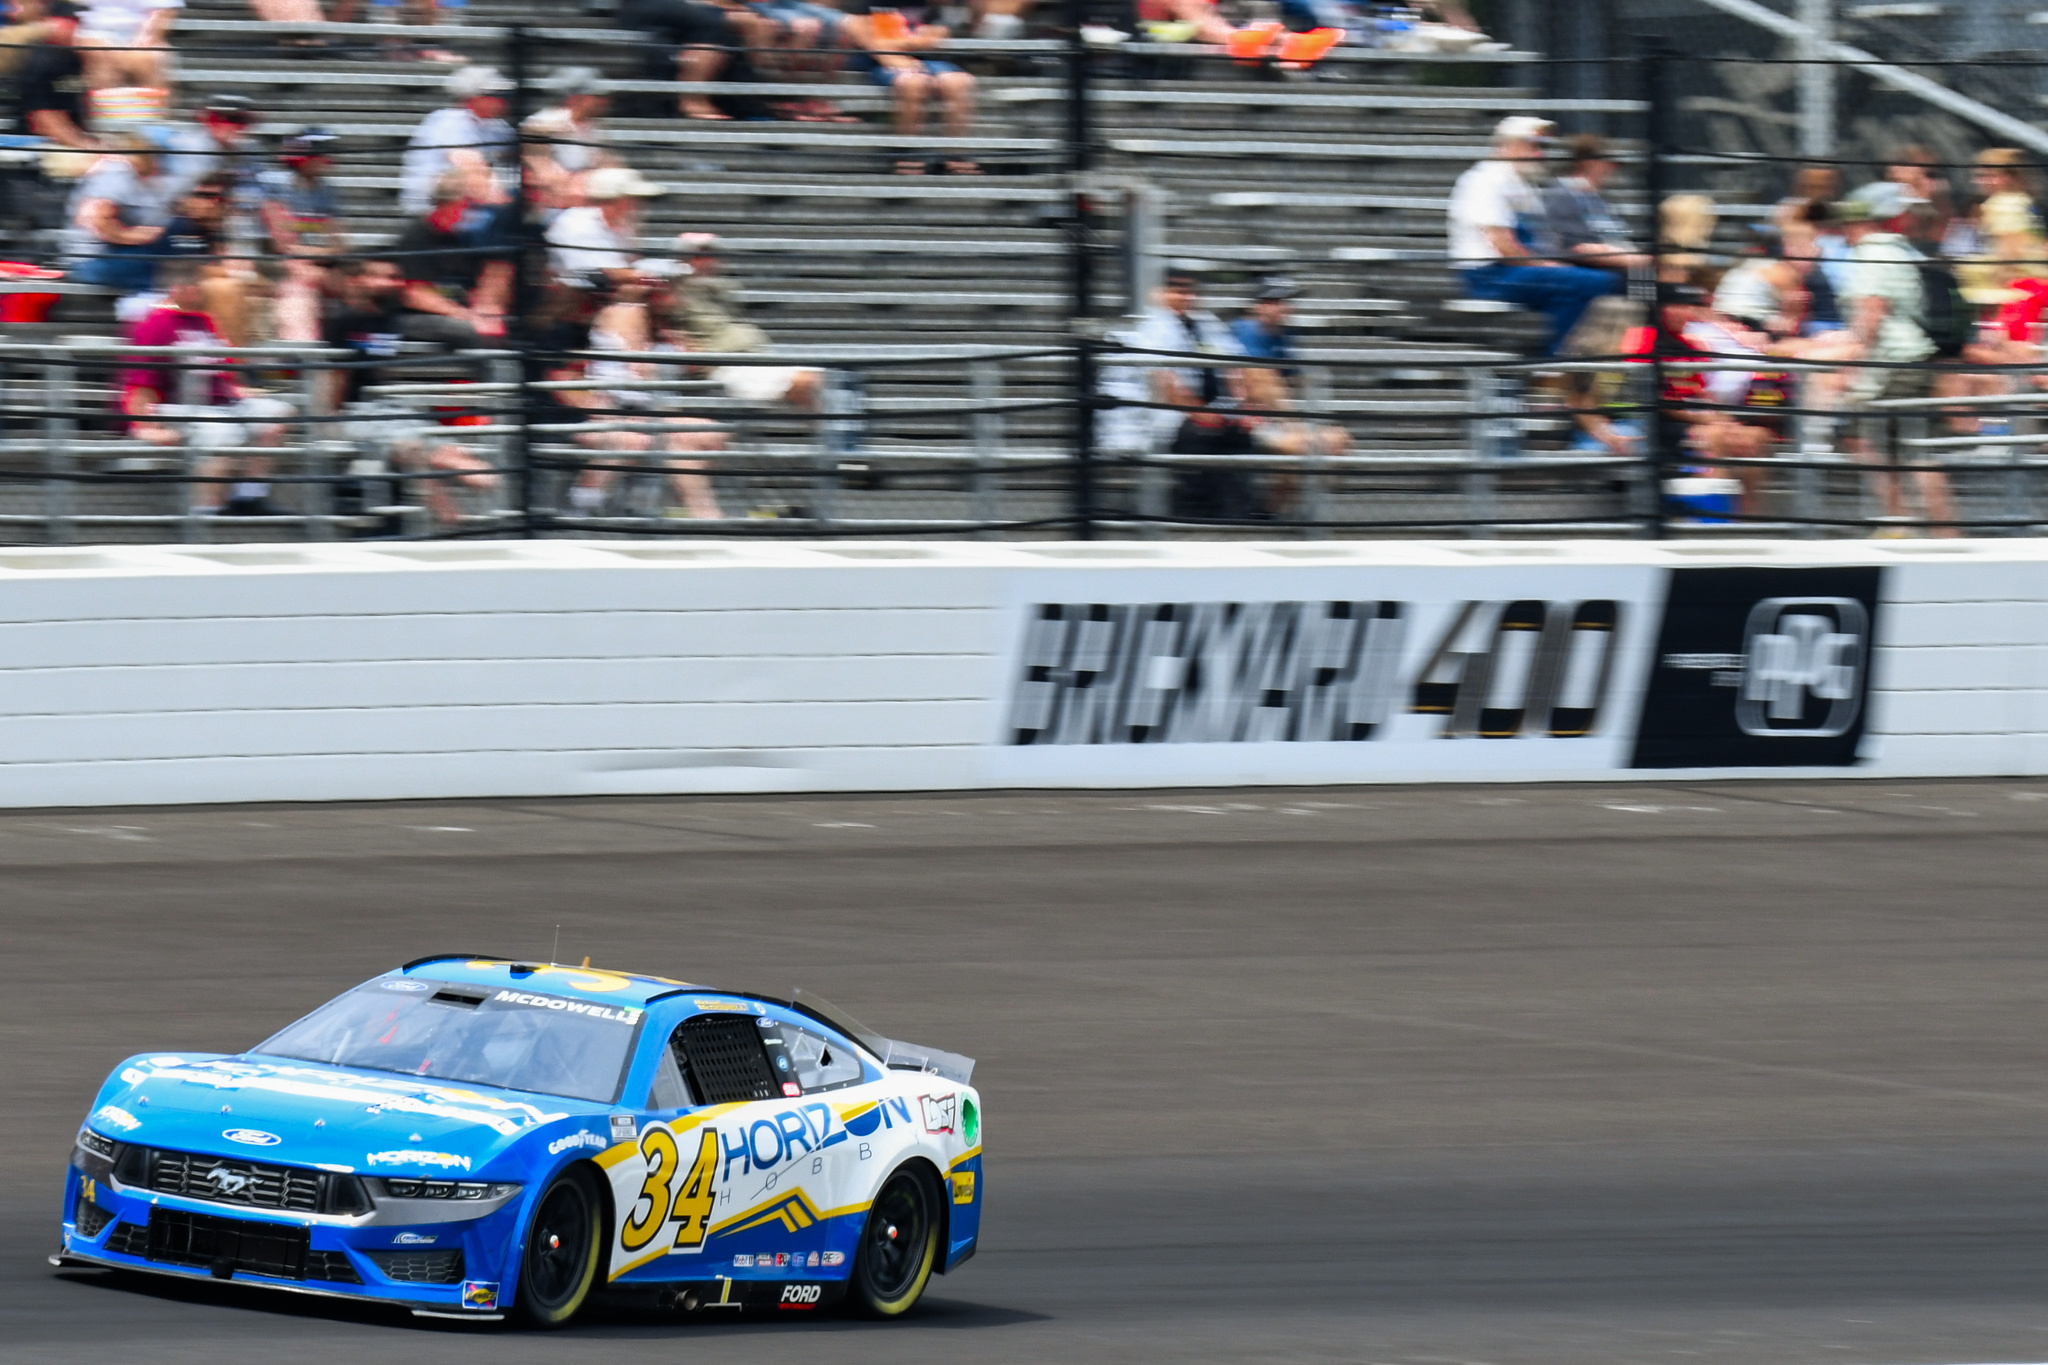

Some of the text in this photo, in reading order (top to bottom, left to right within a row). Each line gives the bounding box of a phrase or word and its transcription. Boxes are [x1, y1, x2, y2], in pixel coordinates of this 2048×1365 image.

[1412, 600, 1624, 739] 400
[494, 990, 633, 1022] MCDOWELL
[548, 1129, 607, 1155] GOODYEAR
[720, 1096, 912, 1183] HORIZON
[367, 1150, 471, 1171] HORIZON
[621, 1126, 719, 1253] 34
[781, 1285, 821, 1302] FORD
